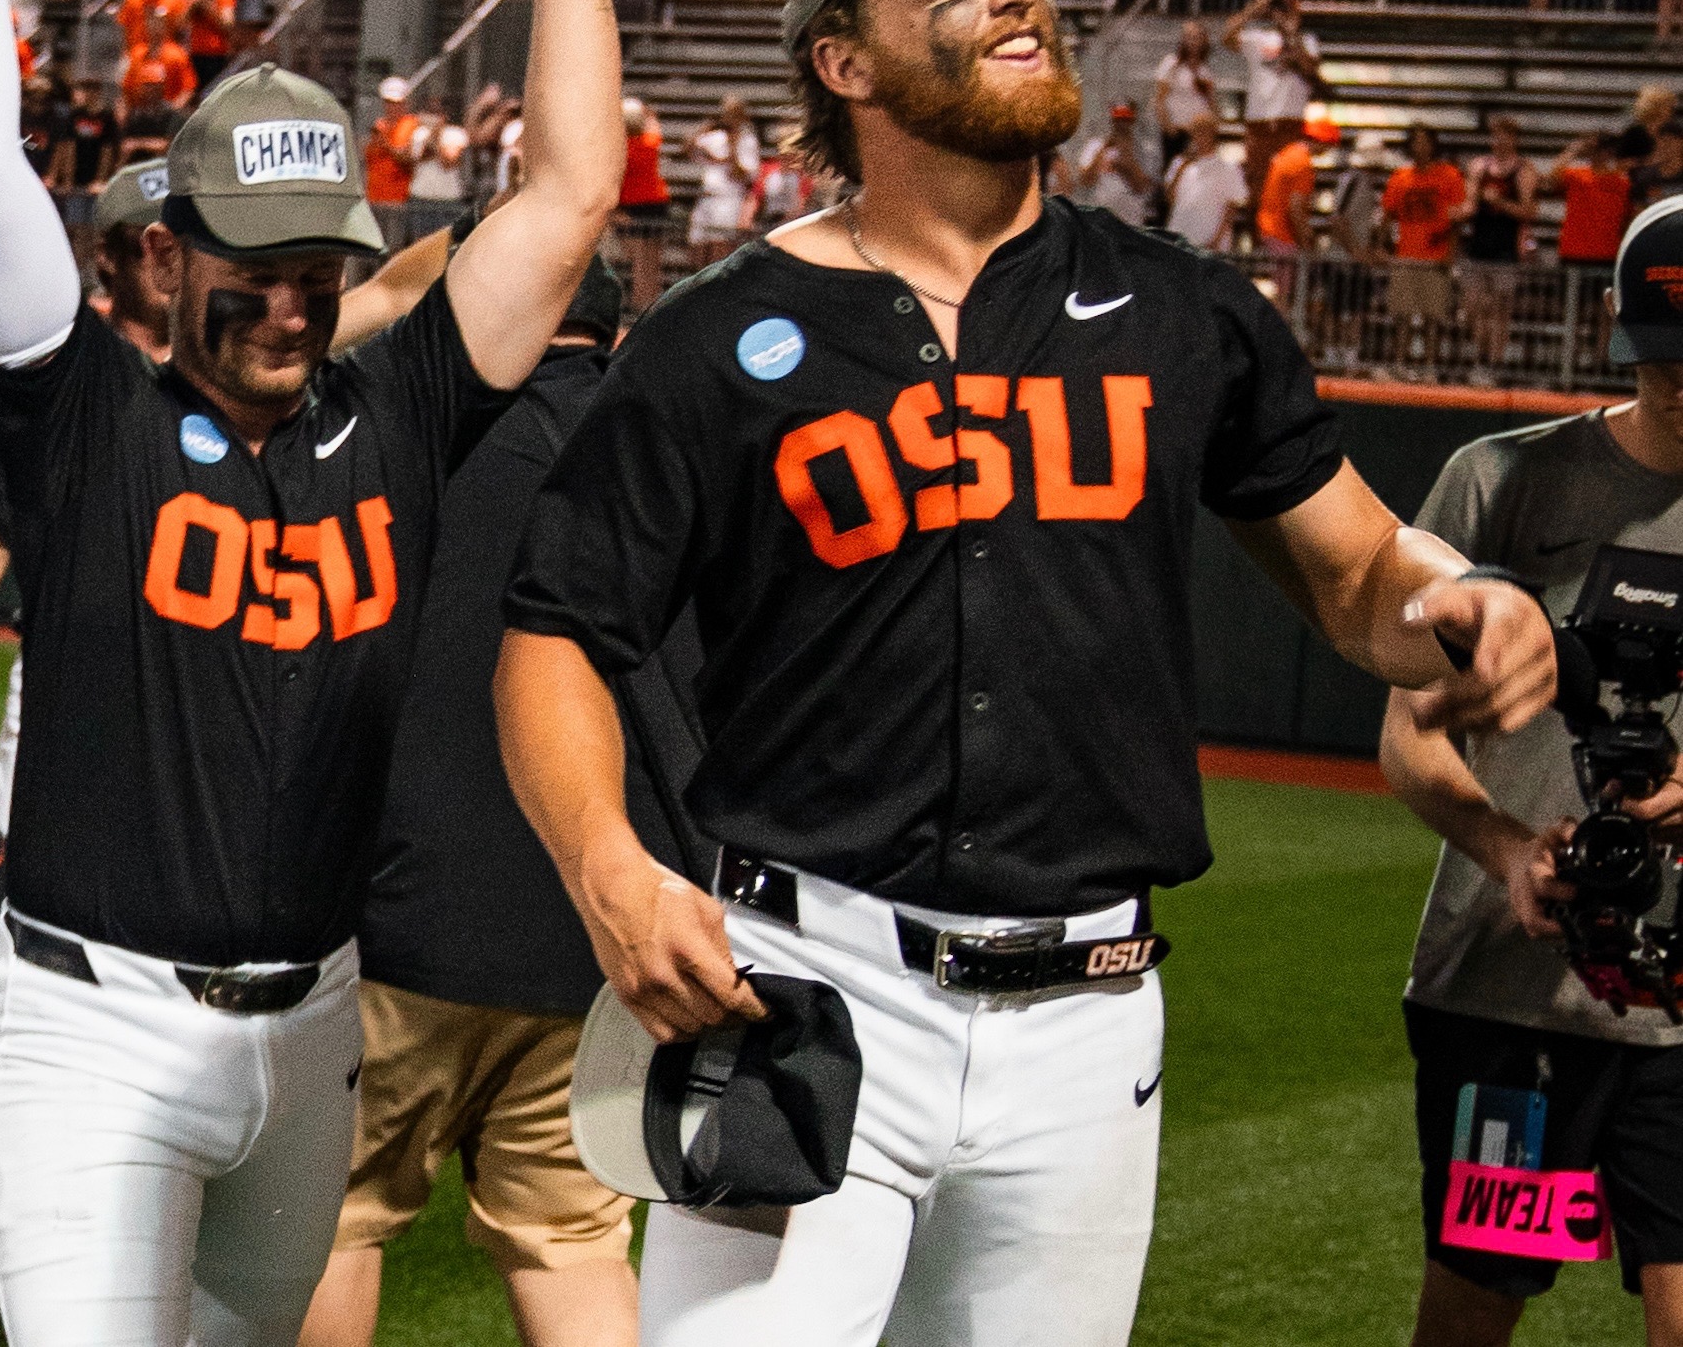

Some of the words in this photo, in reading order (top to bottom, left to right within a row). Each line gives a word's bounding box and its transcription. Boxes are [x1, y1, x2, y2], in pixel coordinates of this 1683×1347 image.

[774, 373, 1154, 569] OSU
[143, 492, 398, 651] OSU
[1085, 938, 1156, 978] OSU
[1456, 1174, 1555, 1235] TEAM
